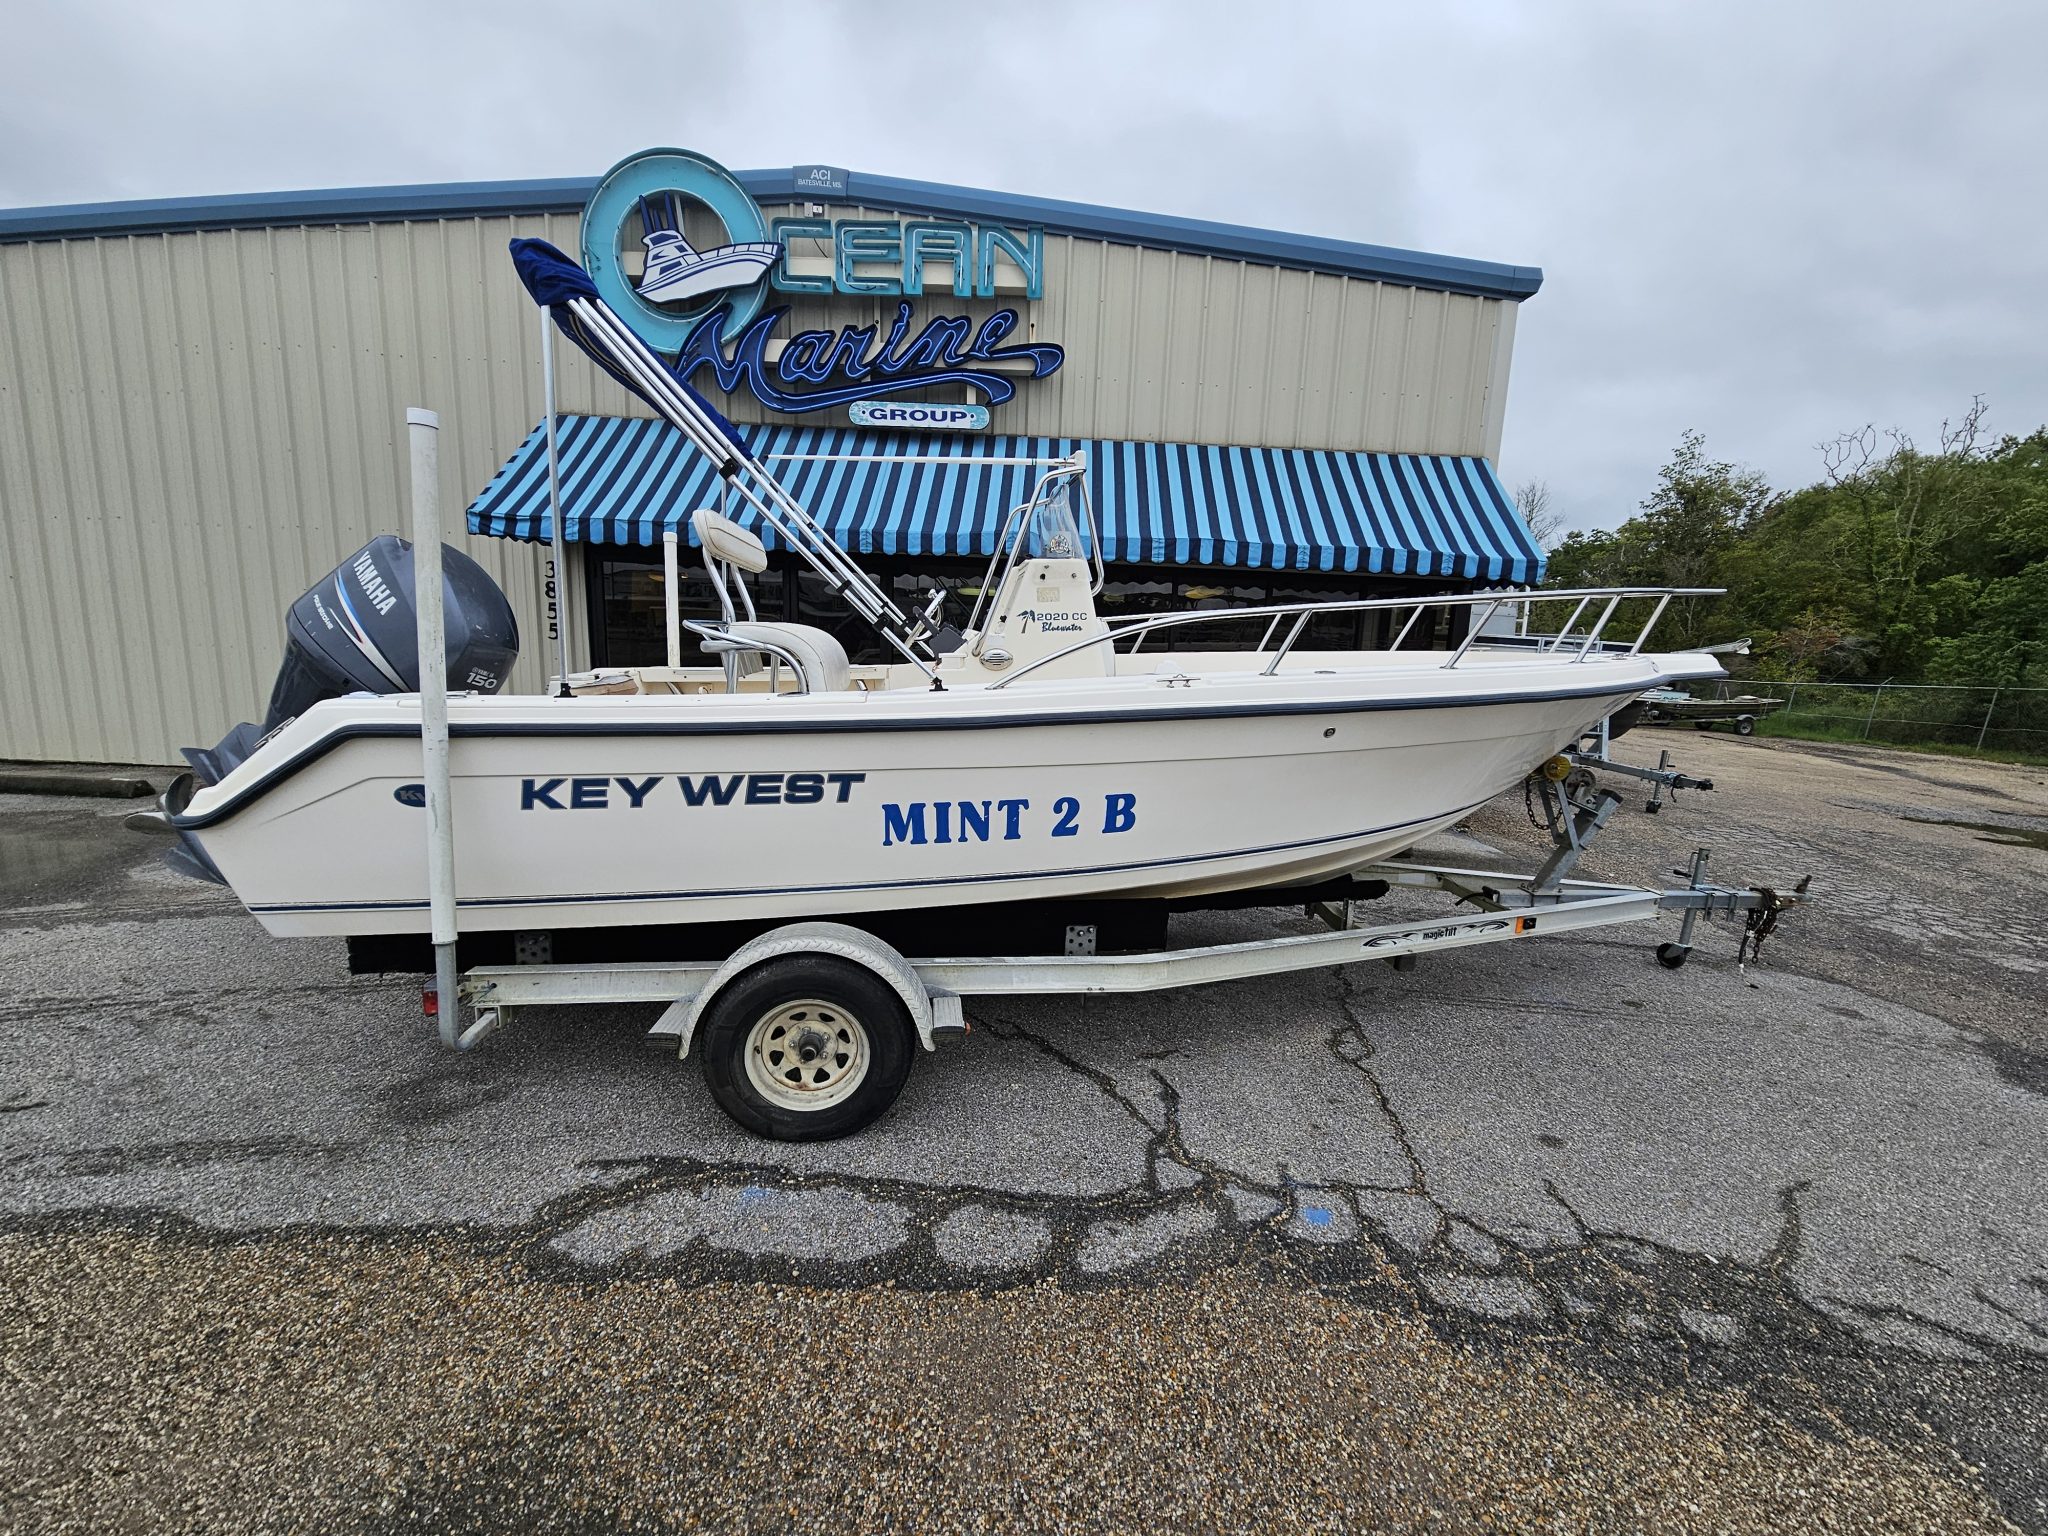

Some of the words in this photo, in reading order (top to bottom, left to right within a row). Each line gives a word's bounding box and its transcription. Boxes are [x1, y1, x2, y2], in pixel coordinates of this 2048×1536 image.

[810, 169, 831, 180] ACI
[580, 147, 1045, 355] OCEAN
[673, 301, 1066, 414] Marine
[868, 408, 968, 423] GROUP
[353, 551, 397, 616] YAMAHA
[544, 560, 559, 640] 3855
[1037, 612, 1069, 621] 2020
[1072, 612, 1088, 621] CC
[1041, 621, 1083, 633] Bluewater
[466, 672, 497, 689] 150
[521, 777, 664, 810] KEY
[677, 773, 866, 807] WEST
[882, 799, 1029, 847] MINT
[1051, 797, 1080, 837] 2
[1102, 793, 1137, 834] B
